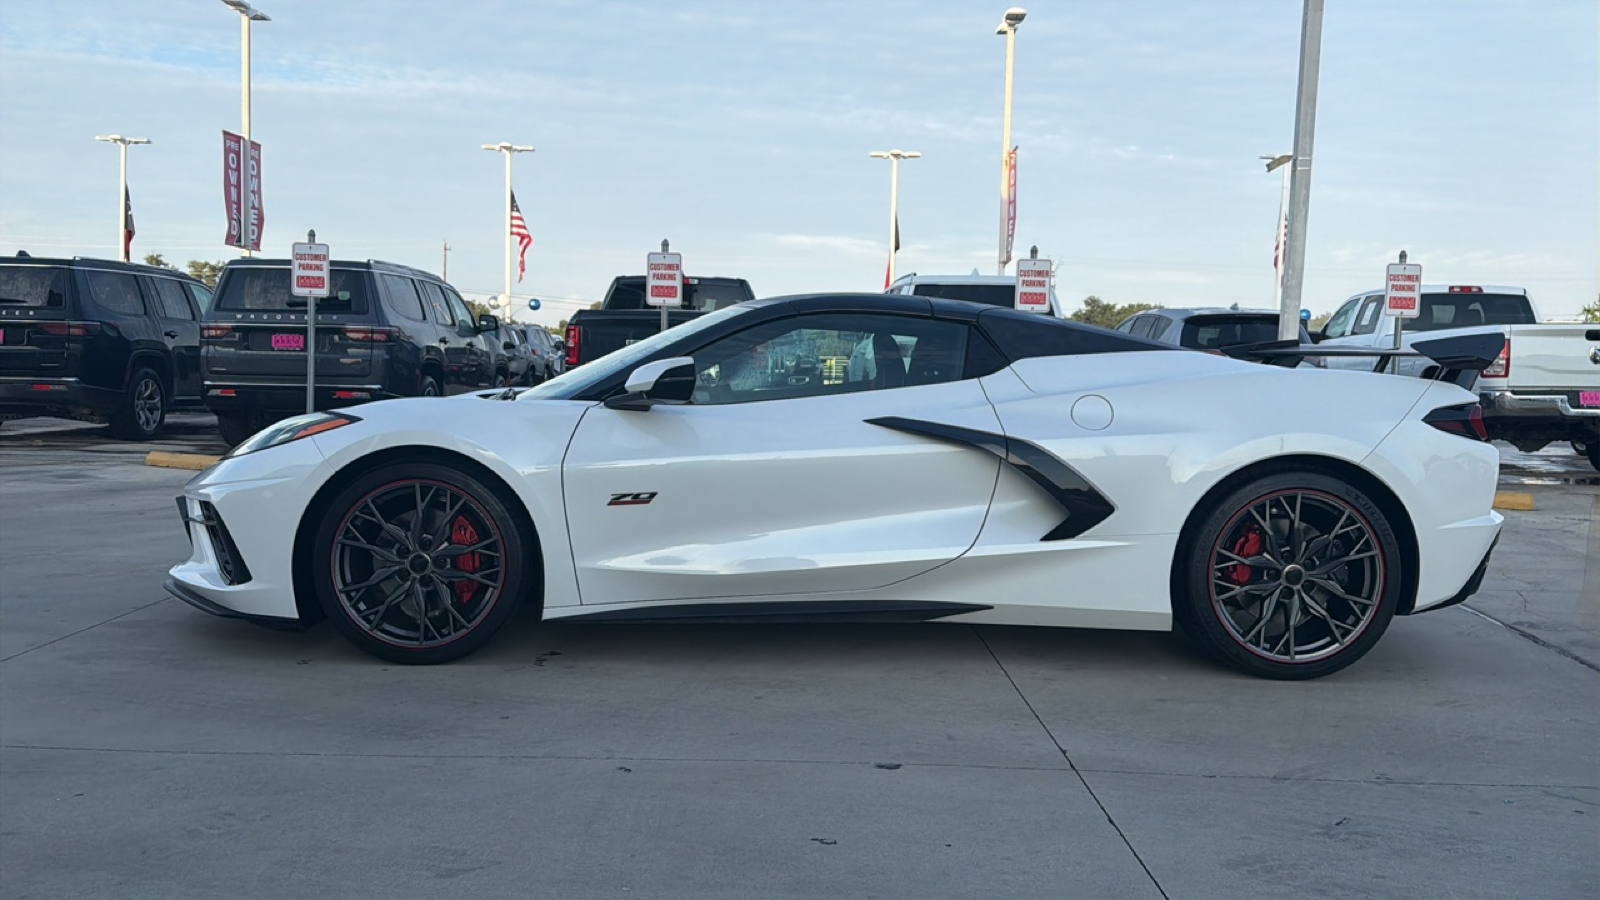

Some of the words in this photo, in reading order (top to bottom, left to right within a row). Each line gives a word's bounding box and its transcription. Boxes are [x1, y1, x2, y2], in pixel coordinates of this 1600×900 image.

[225, 139, 240, 151] PRE
[228, 152, 239, 236] OWNED
[250, 160, 260, 242] OWNED
[295, 252, 327, 261] CUSTOMER
[298, 262, 325, 271] PARKING
[650, 262, 680, 271] CUSTOMER
[652, 272, 677, 281] PARKING
[1019, 269, 1050, 278] CUSTOMER
[1389, 274, 1420, 282] CUSTOMER
[1021, 279, 1046, 288] PARKING
[1390, 284, 1415, 292] PARKING
[606, 491, 658, 506] 70
